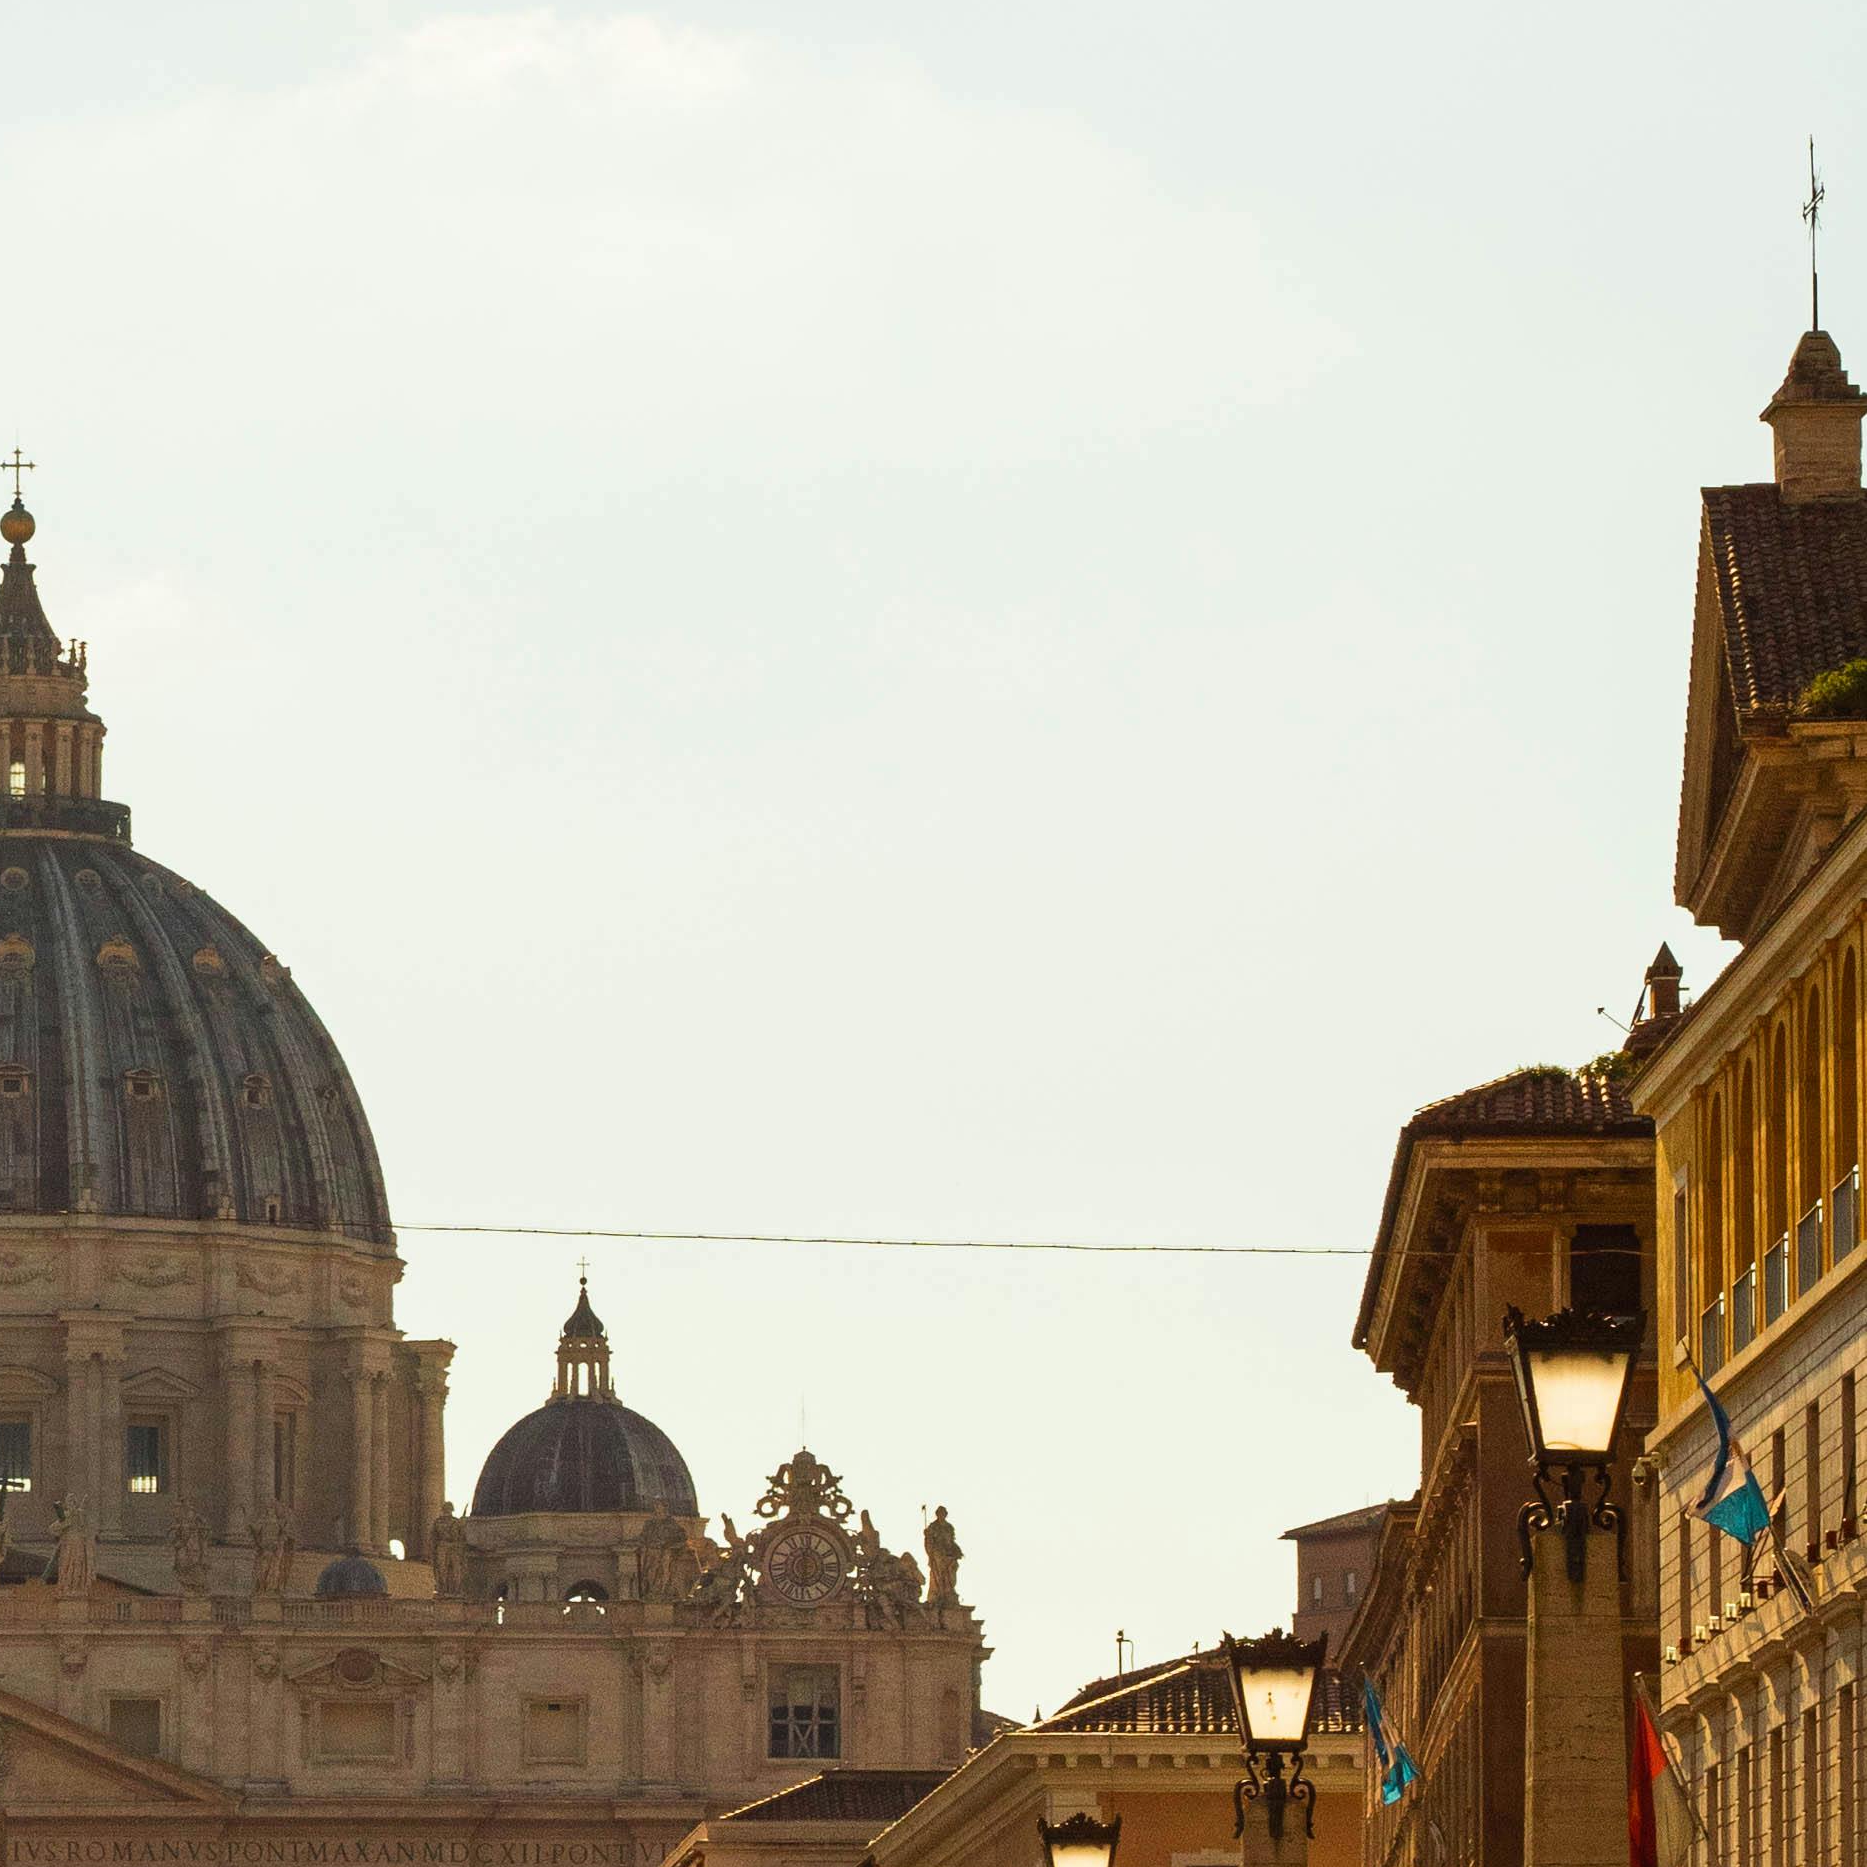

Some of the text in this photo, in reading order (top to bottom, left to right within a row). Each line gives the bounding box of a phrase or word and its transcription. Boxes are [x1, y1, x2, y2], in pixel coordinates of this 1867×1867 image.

[66, 1841, 220, 1862] ROMANVS
[227, 1841, 302, 1863] PONT
[306, 1842, 372, 1863] MAX
